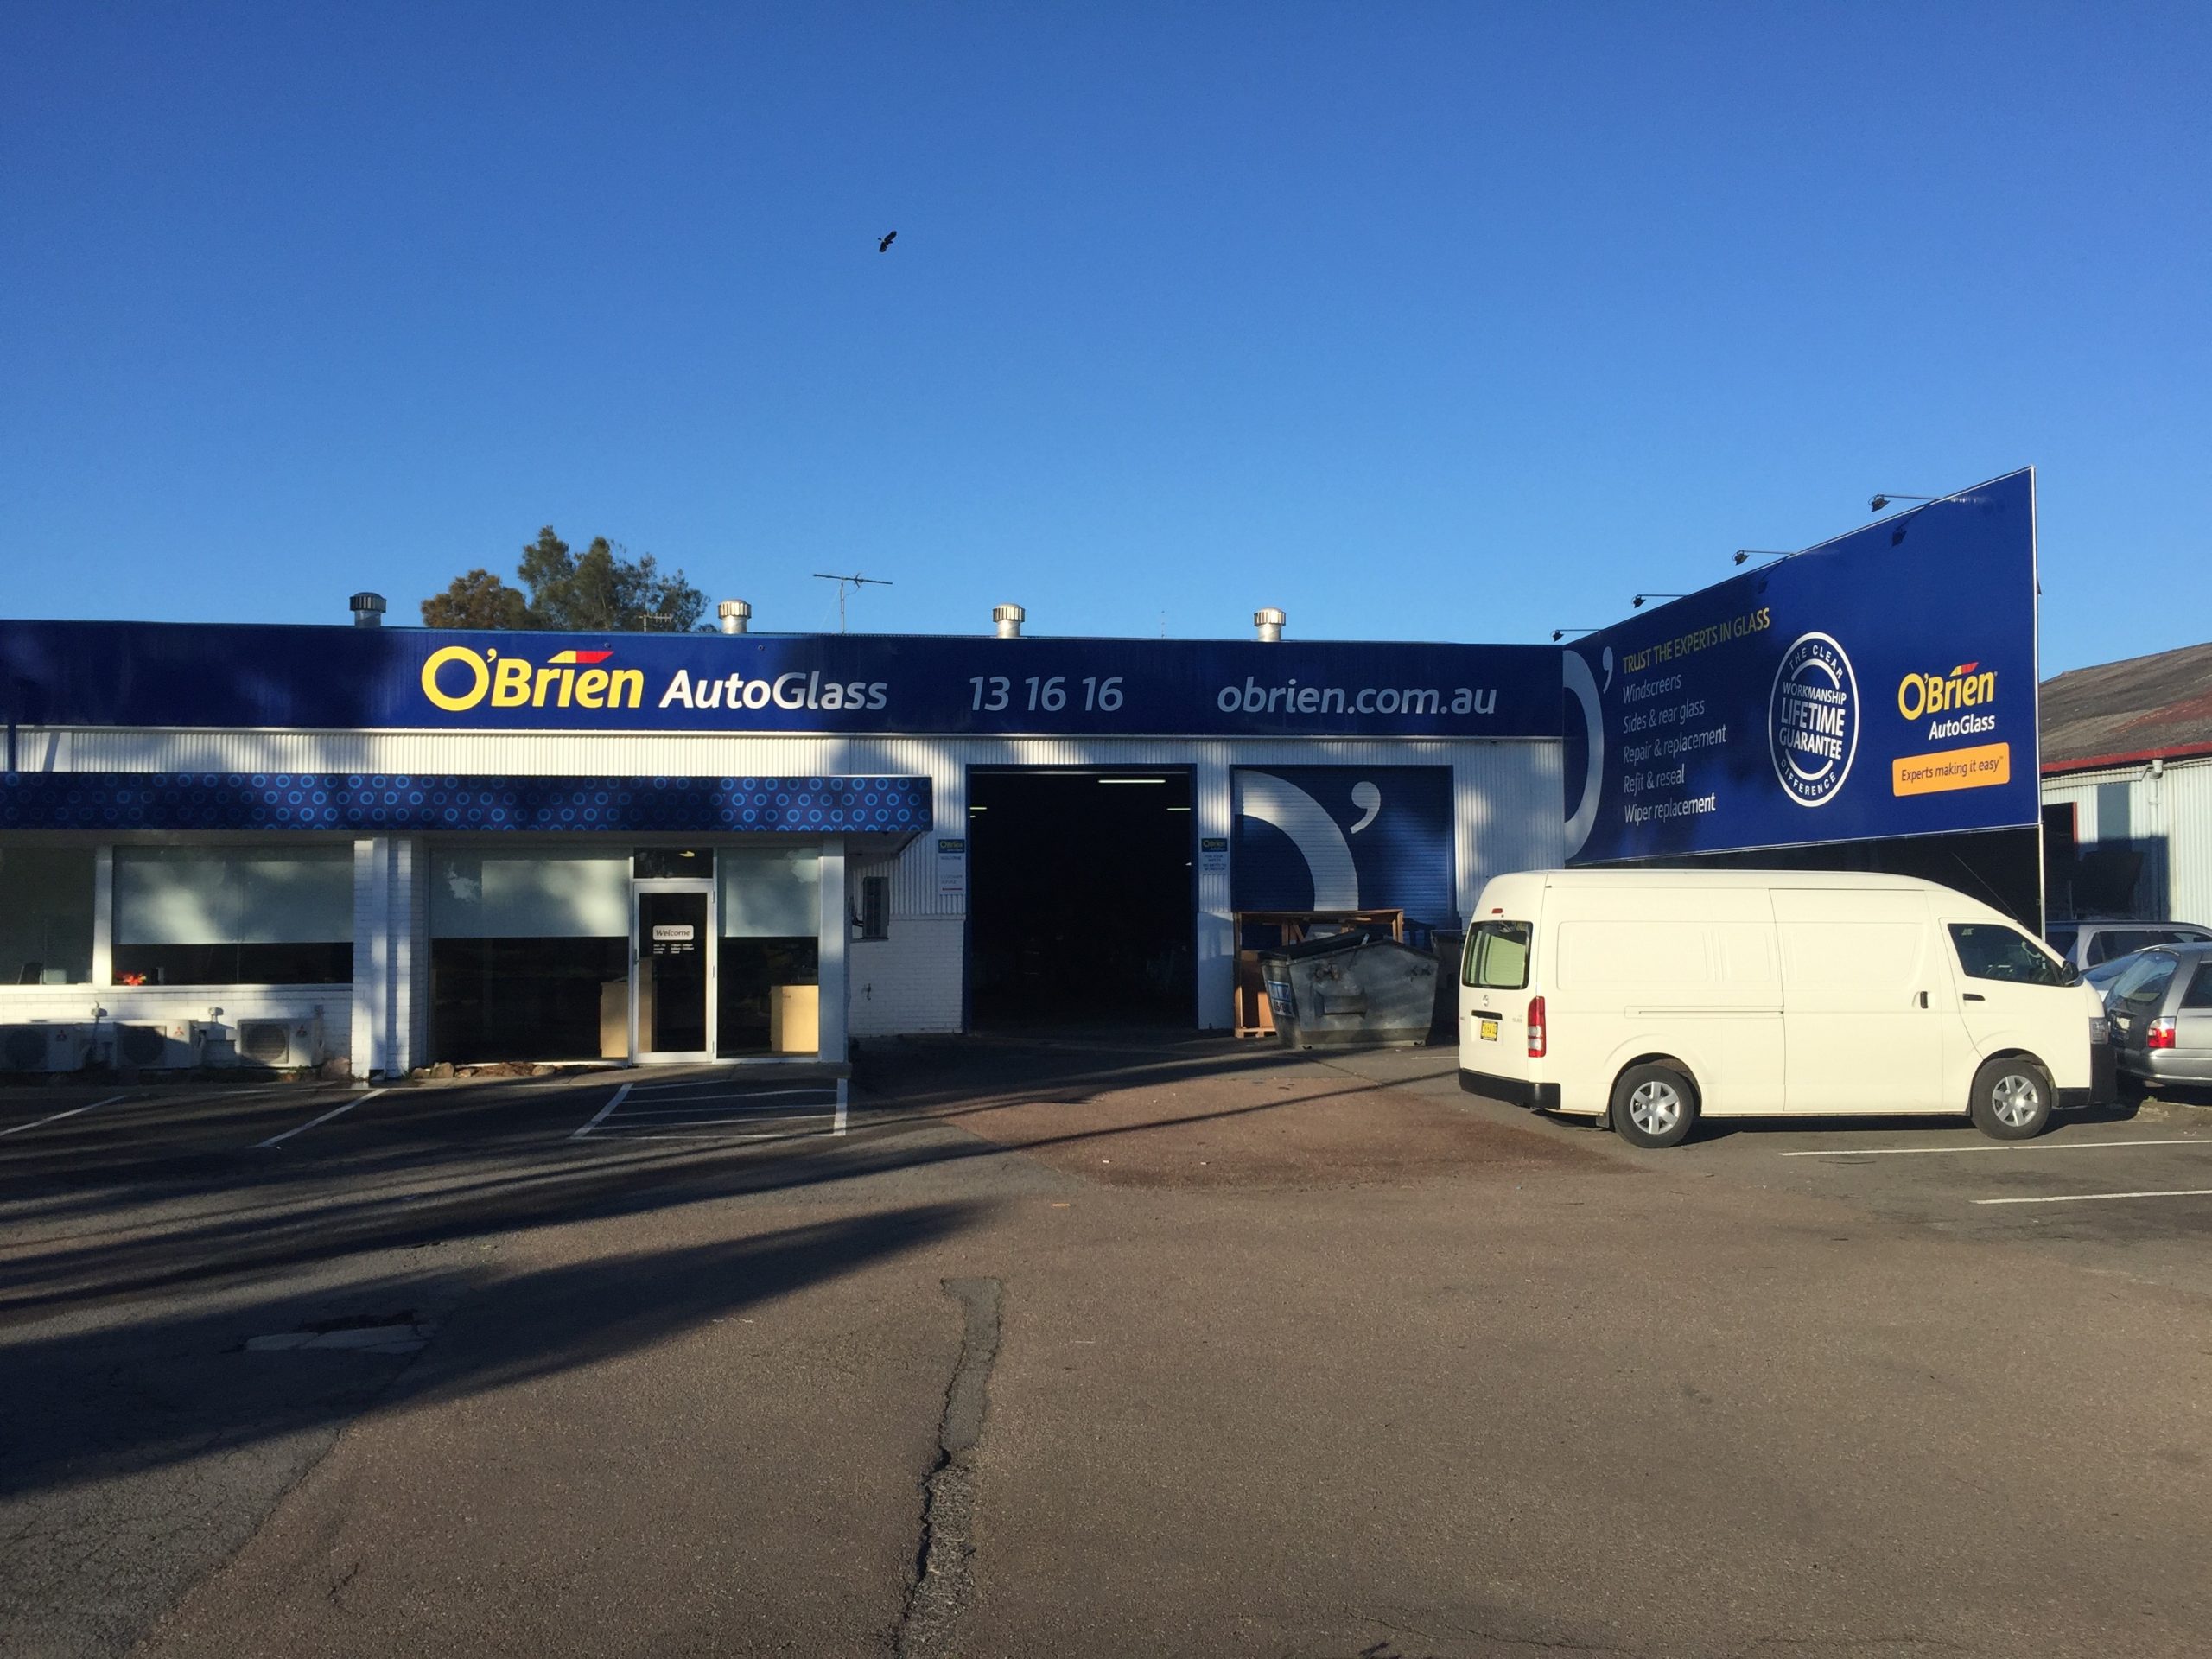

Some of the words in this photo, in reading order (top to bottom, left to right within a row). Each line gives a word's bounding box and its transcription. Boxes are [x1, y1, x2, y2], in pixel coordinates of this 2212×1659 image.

[1623, 650, 1651, 674] TRUST
[1654, 641, 1673, 662] THE
[1675, 626, 1718, 657] EXPERTS
[1720, 622, 1732, 641] IN
[1734, 607, 1770, 638] GLASS
[422, 646, 644, 711] O'Brien
[658, 669, 887, 710] AutoGlass
[1789, 647, 1808, 670] THE
[1812, 645, 1843, 679] CLEAR
[969, 676, 1009, 711] 13
[1024, 677, 1066, 712] 16
[1082, 677, 1123, 712] 16
[1217, 676, 1497, 715] obrien.com.au
[1623, 674, 1681, 704] Windscreens
[1783, 681, 1847, 705] WORKMANSHIP
[1897, 671, 1995, 720] O'Brien
[1624, 711, 1646, 734] Sides
[1649, 709, 1656, 726] &
[1658, 707, 1678, 723] rear
[1680, 698, 1705, 726] glass
[1780, 697, 1846, 737] LIFETIME
[1928, 714, 1995, 741] AutoGlass
[1624, 741, 1651, 766] Repair
[1654, 739, 1662, 757] &
[1663, 724, 1726, 759] replacement
[1779, 727, 1843, 760] GUARANTEE
[1624, 772, 1643, 797] Refit
[1646, 772, 1654, 790] &
[1656, 763, 1684, 787] reseal
[1781, 759, 1836, 796] DIFFERENCE
[1901, 766, 1933, 783] Experts
[1935, 762, 1967, 777] making
[1969, 760, 1976, 772] it
[1979, 759, 1999, 772] easy
[1624, 803, 1652, 826] Wiper
[1654, 792, 1716, 823] replacement
